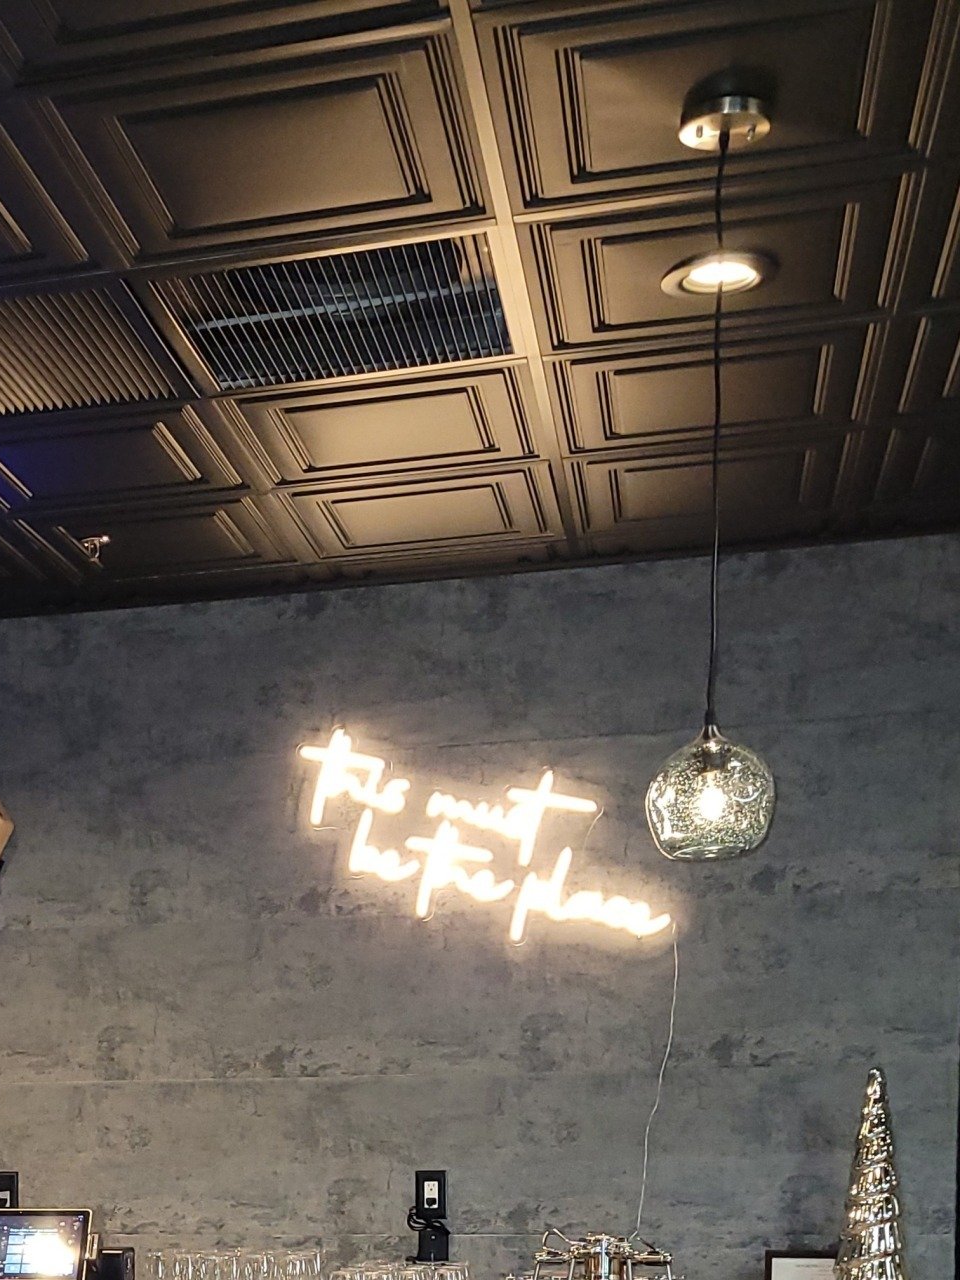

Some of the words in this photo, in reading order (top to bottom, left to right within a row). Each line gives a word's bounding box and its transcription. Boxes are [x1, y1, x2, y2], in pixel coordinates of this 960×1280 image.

[299, 728, 411, 824] this
[426, 769, 598, 866] must
[348, 808, 421, 881] be
[405, 819, 516, 917] the
[510, 845, 672, 942] place
